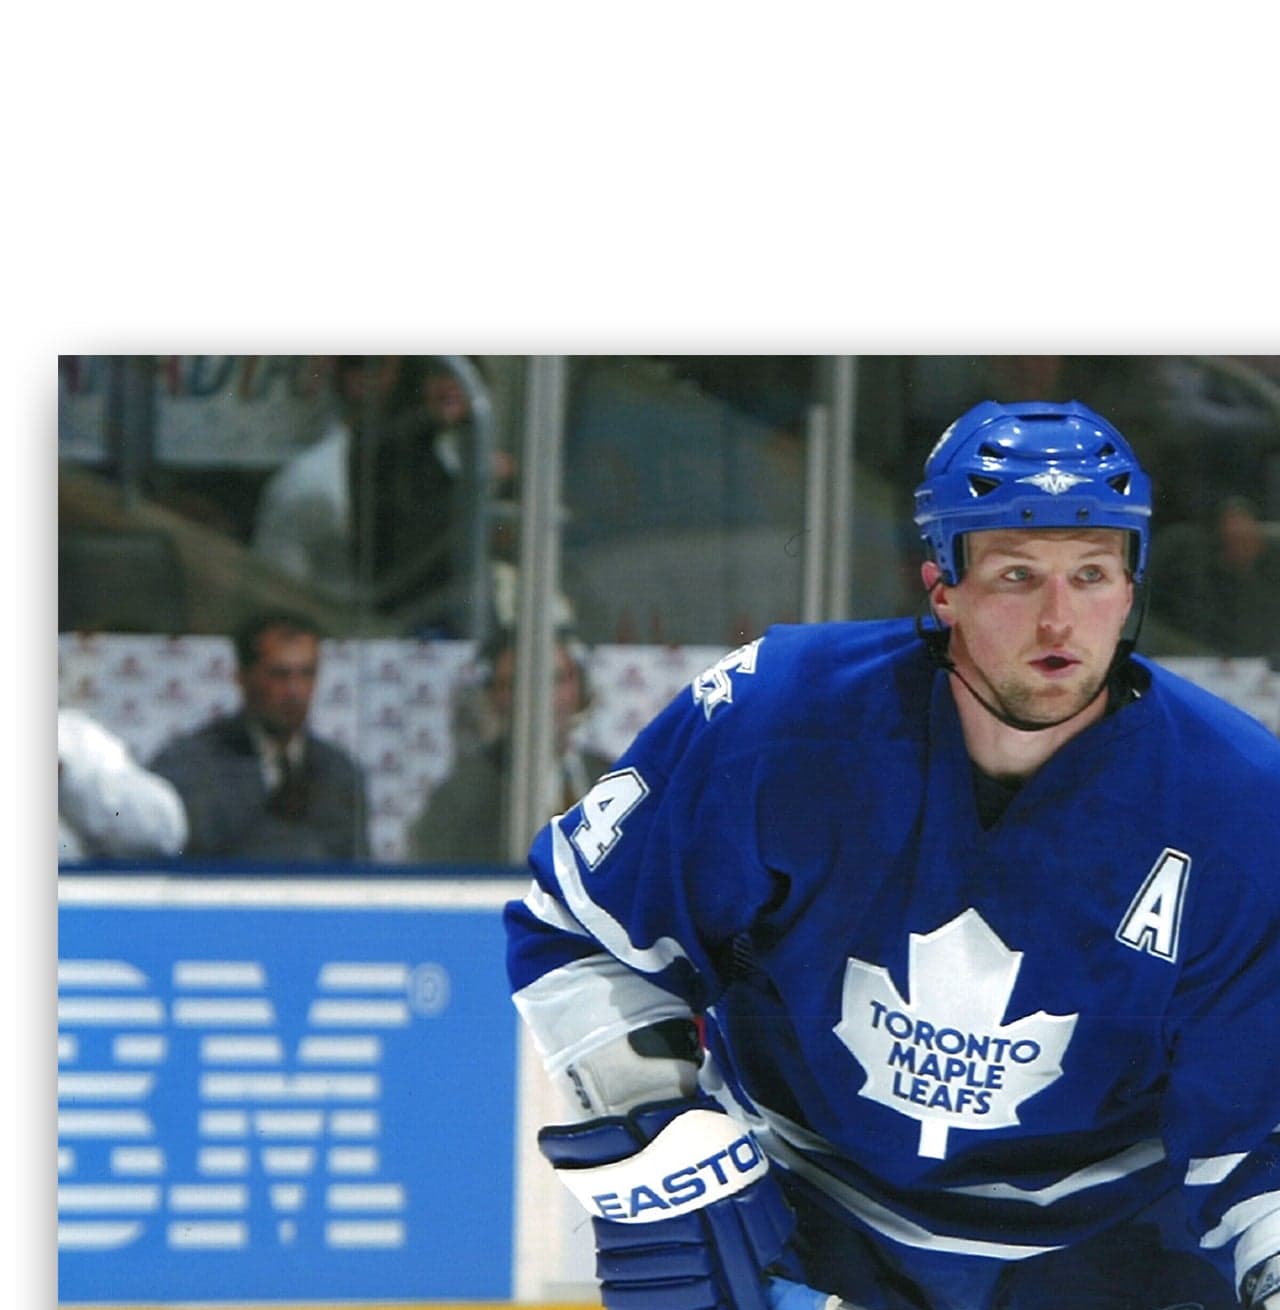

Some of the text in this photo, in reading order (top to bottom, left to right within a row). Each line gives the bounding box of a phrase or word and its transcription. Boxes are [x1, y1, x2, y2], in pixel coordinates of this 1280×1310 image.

[1115, 847, 1191, 964] A
[870, 1000, 1041, 1064] TORONTO
[888, 1041, 1006, 1090] MAPLE
[892, 1071, 993, 1115] LEAFS
